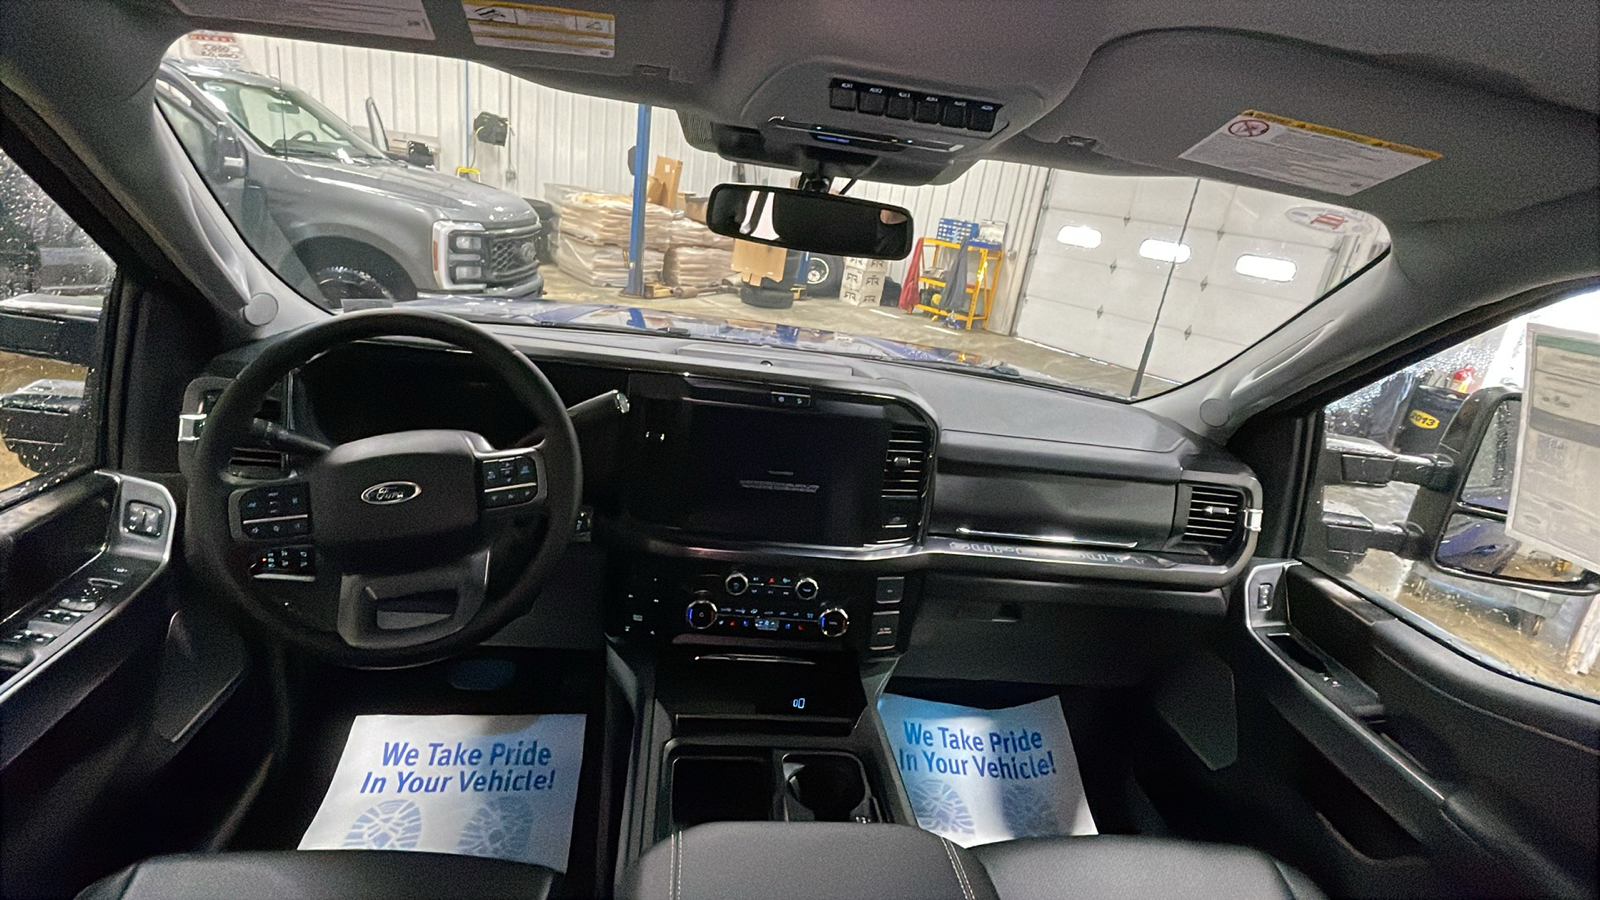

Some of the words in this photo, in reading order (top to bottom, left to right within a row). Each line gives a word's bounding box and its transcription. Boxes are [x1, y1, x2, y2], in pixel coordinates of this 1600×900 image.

[1410, 412, 1436, 426] 2013
[903, 720, 934, 746] We
[937, 726, 984, 752] Take
[989, 728, 1043, 754] Pride
[382, 741, 419, 766] We
[428, 741, 483, 766] Take
[489, 740, 552, 766] Pride
[899, 748, 918, 772] In
[922, 749, 968, 775] Your
[971, 750, 1057, 780] Vehicle!
[360, 771, 387, 794] In
[397, 771, 453, 794] Your
[459, 769, 556, 792] Vehicle!
